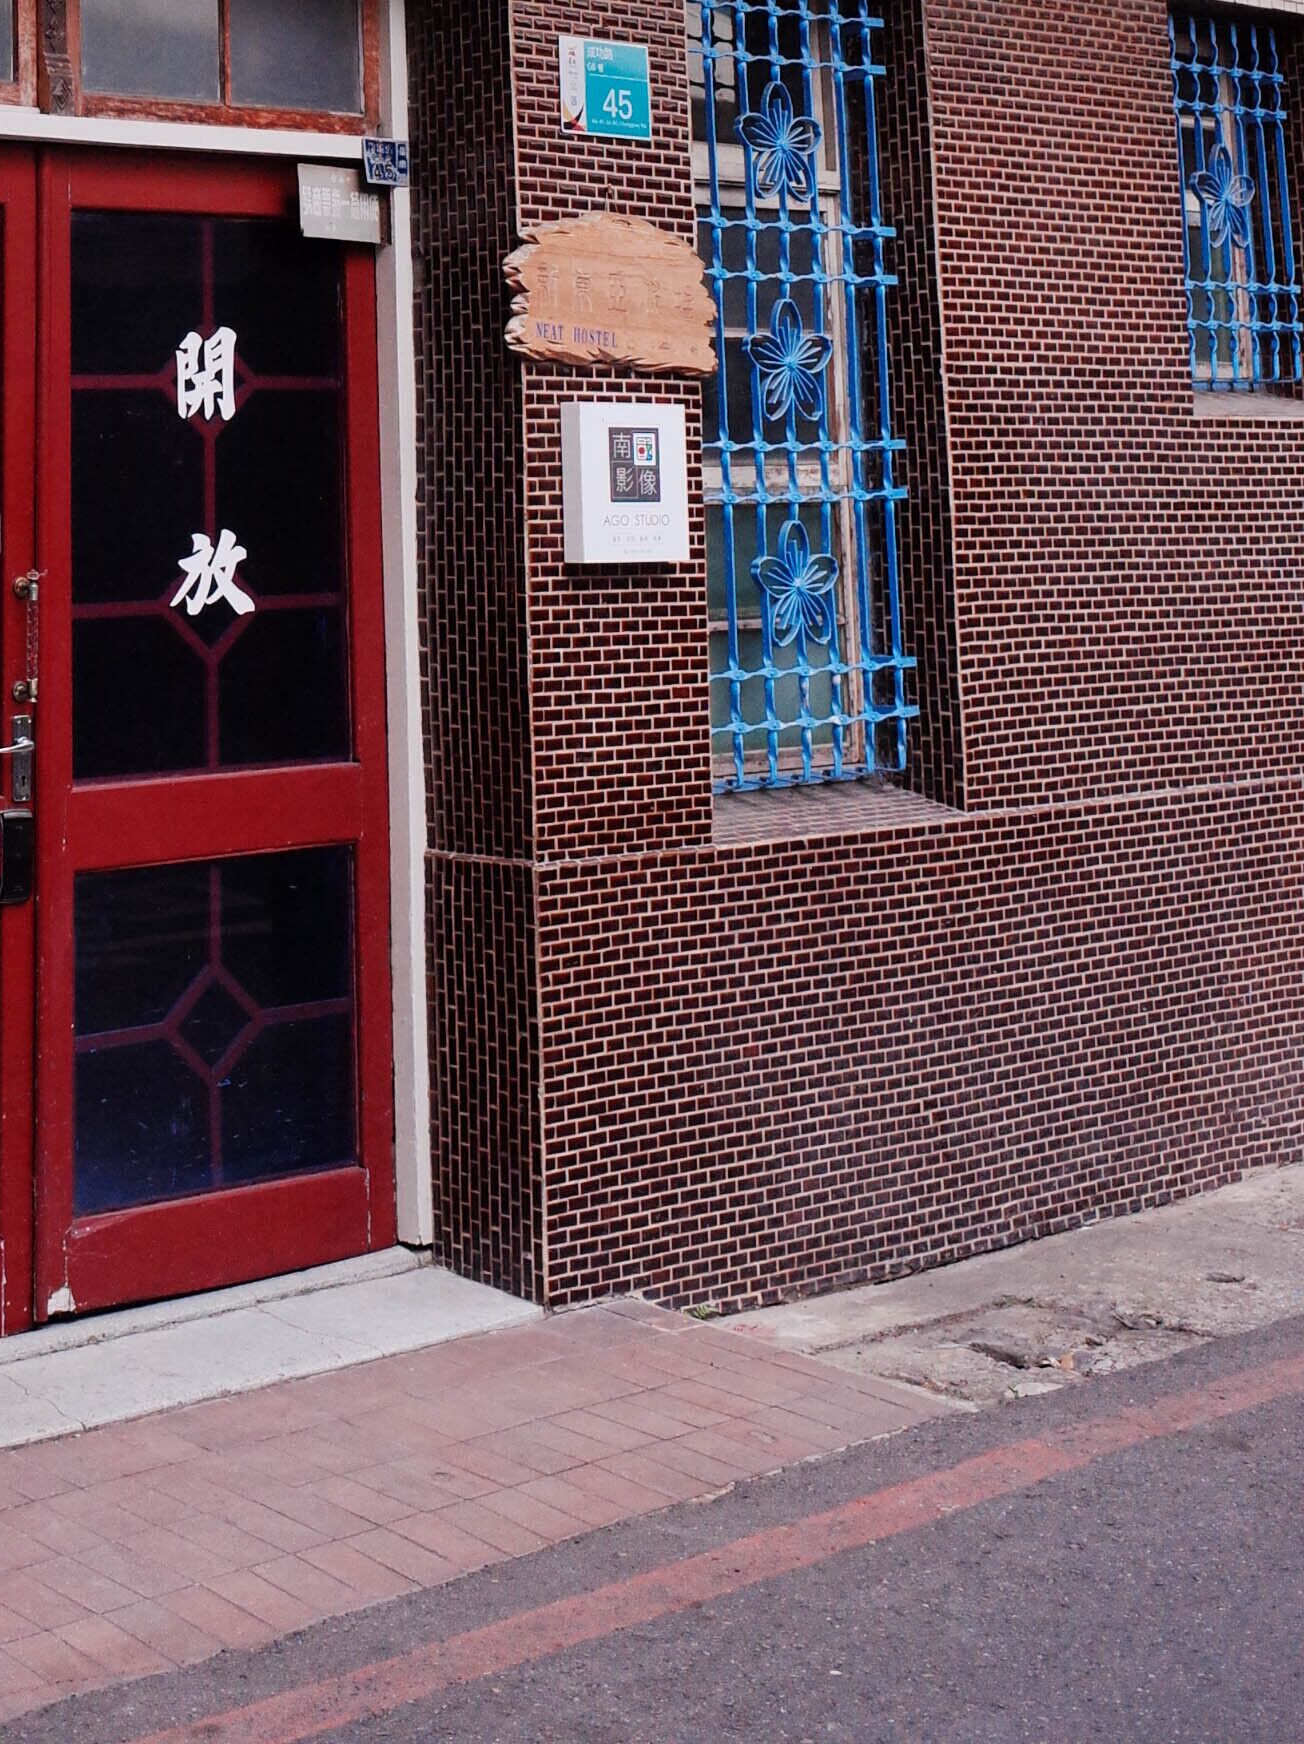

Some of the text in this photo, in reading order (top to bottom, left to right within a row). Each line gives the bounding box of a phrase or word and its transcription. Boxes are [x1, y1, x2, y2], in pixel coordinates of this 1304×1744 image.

[602, 88, 633, 120] 45
[535, 321, 618, 349] NEAT HOSTEL
[603, 514, 670, 527] AGO STUDIO
